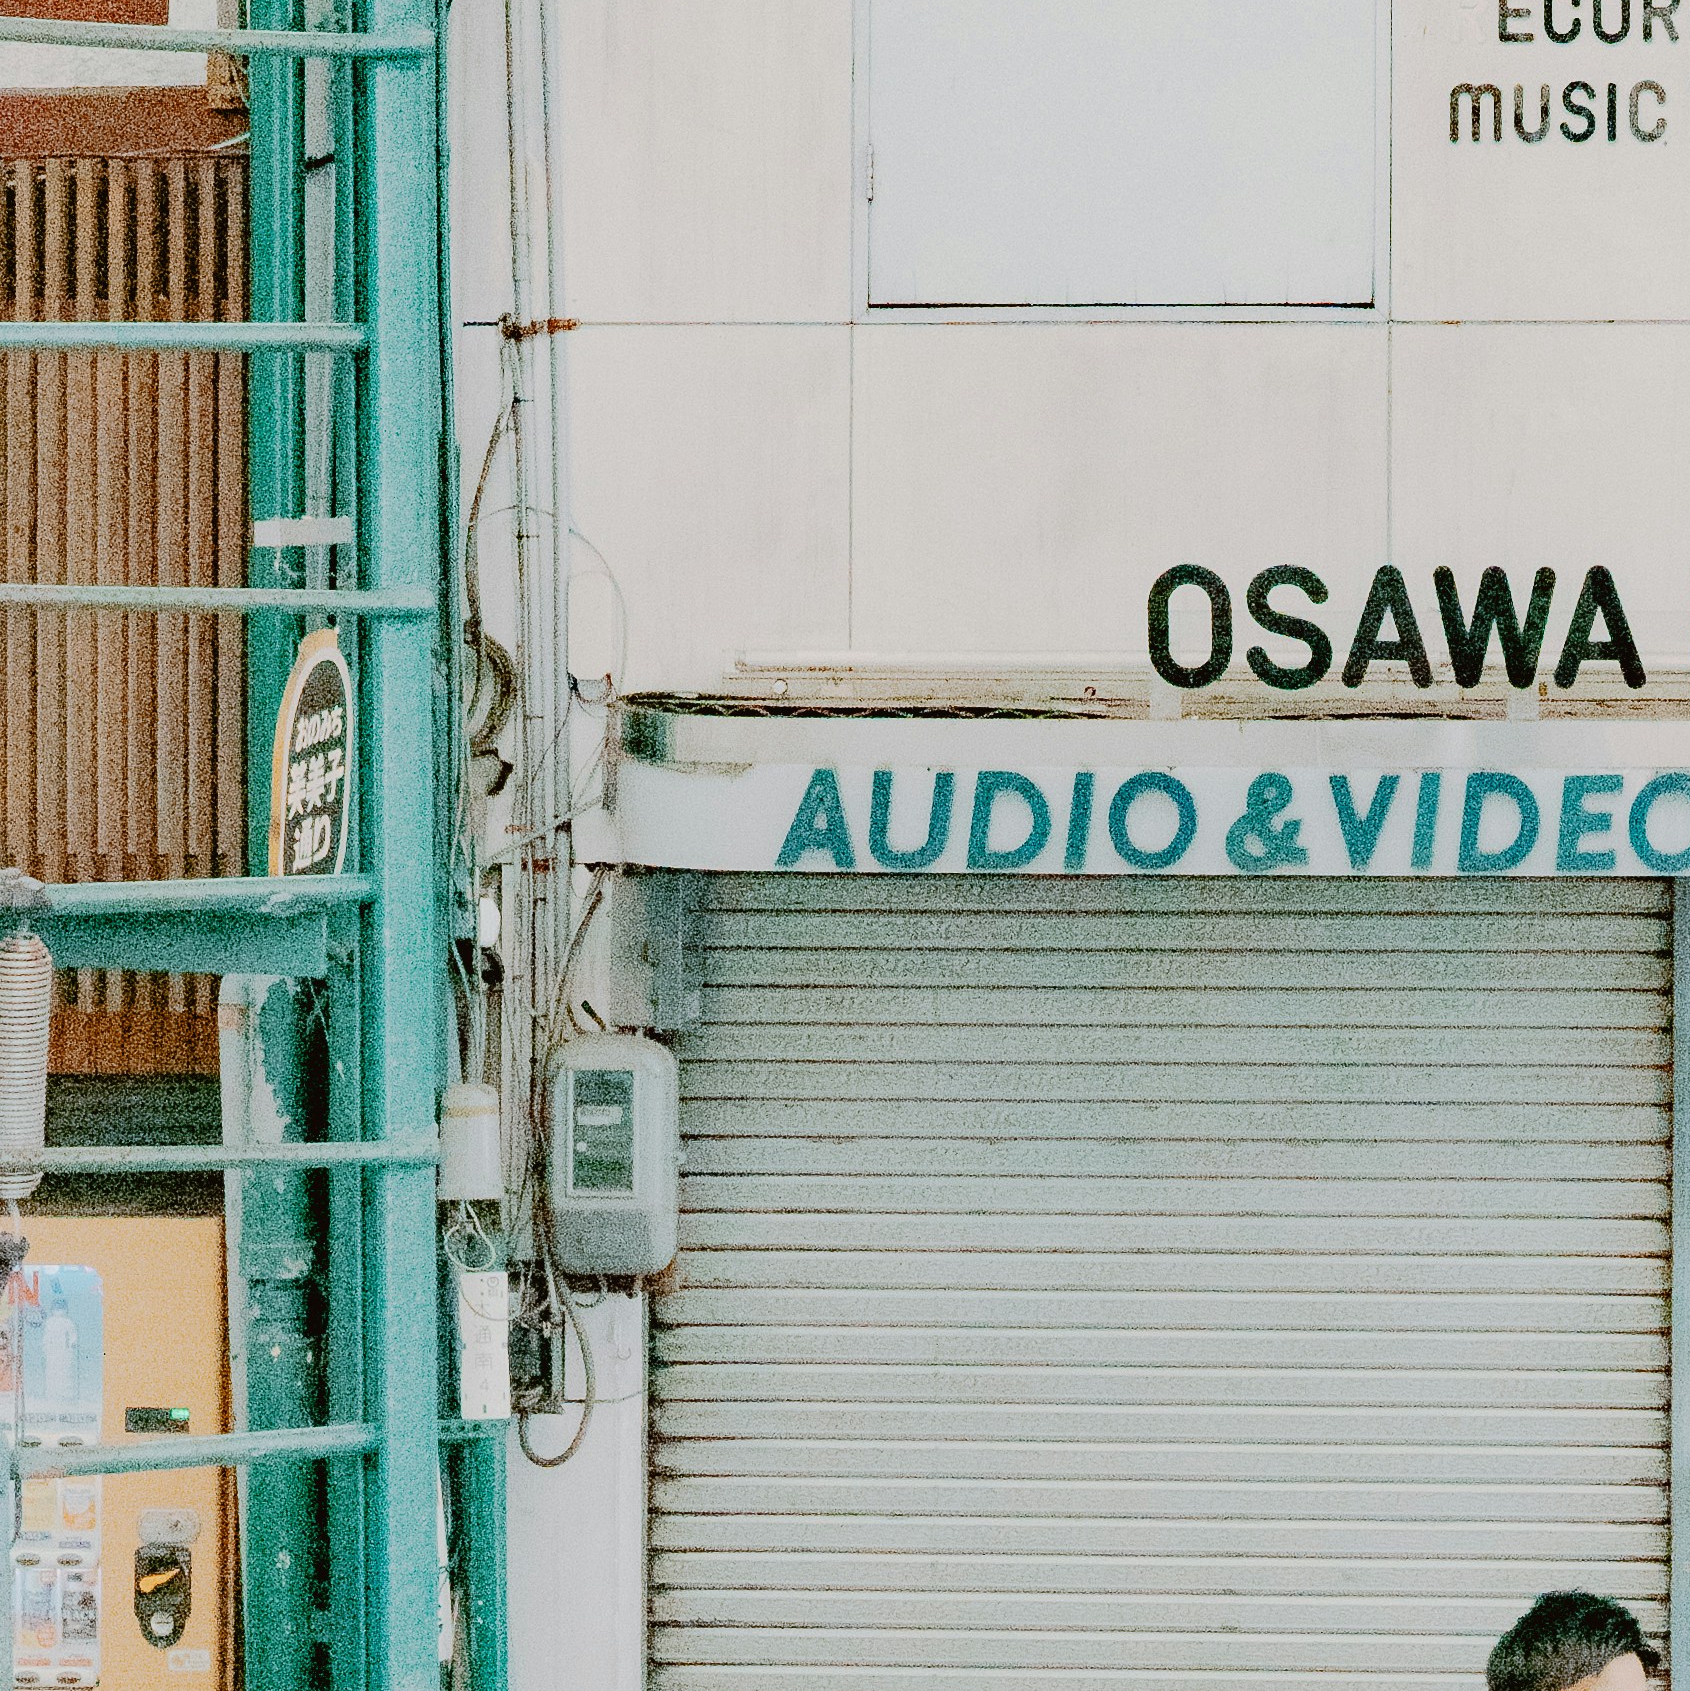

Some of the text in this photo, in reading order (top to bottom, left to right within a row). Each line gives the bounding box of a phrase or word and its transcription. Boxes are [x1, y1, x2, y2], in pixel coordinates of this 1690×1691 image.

[1448, 79, 1667, 143] MUSIC
[1147, 564, 1646, 689] OSAWA
[295, 704, 343, 753] おのみち
[293, 813, 331, 873] 通り
